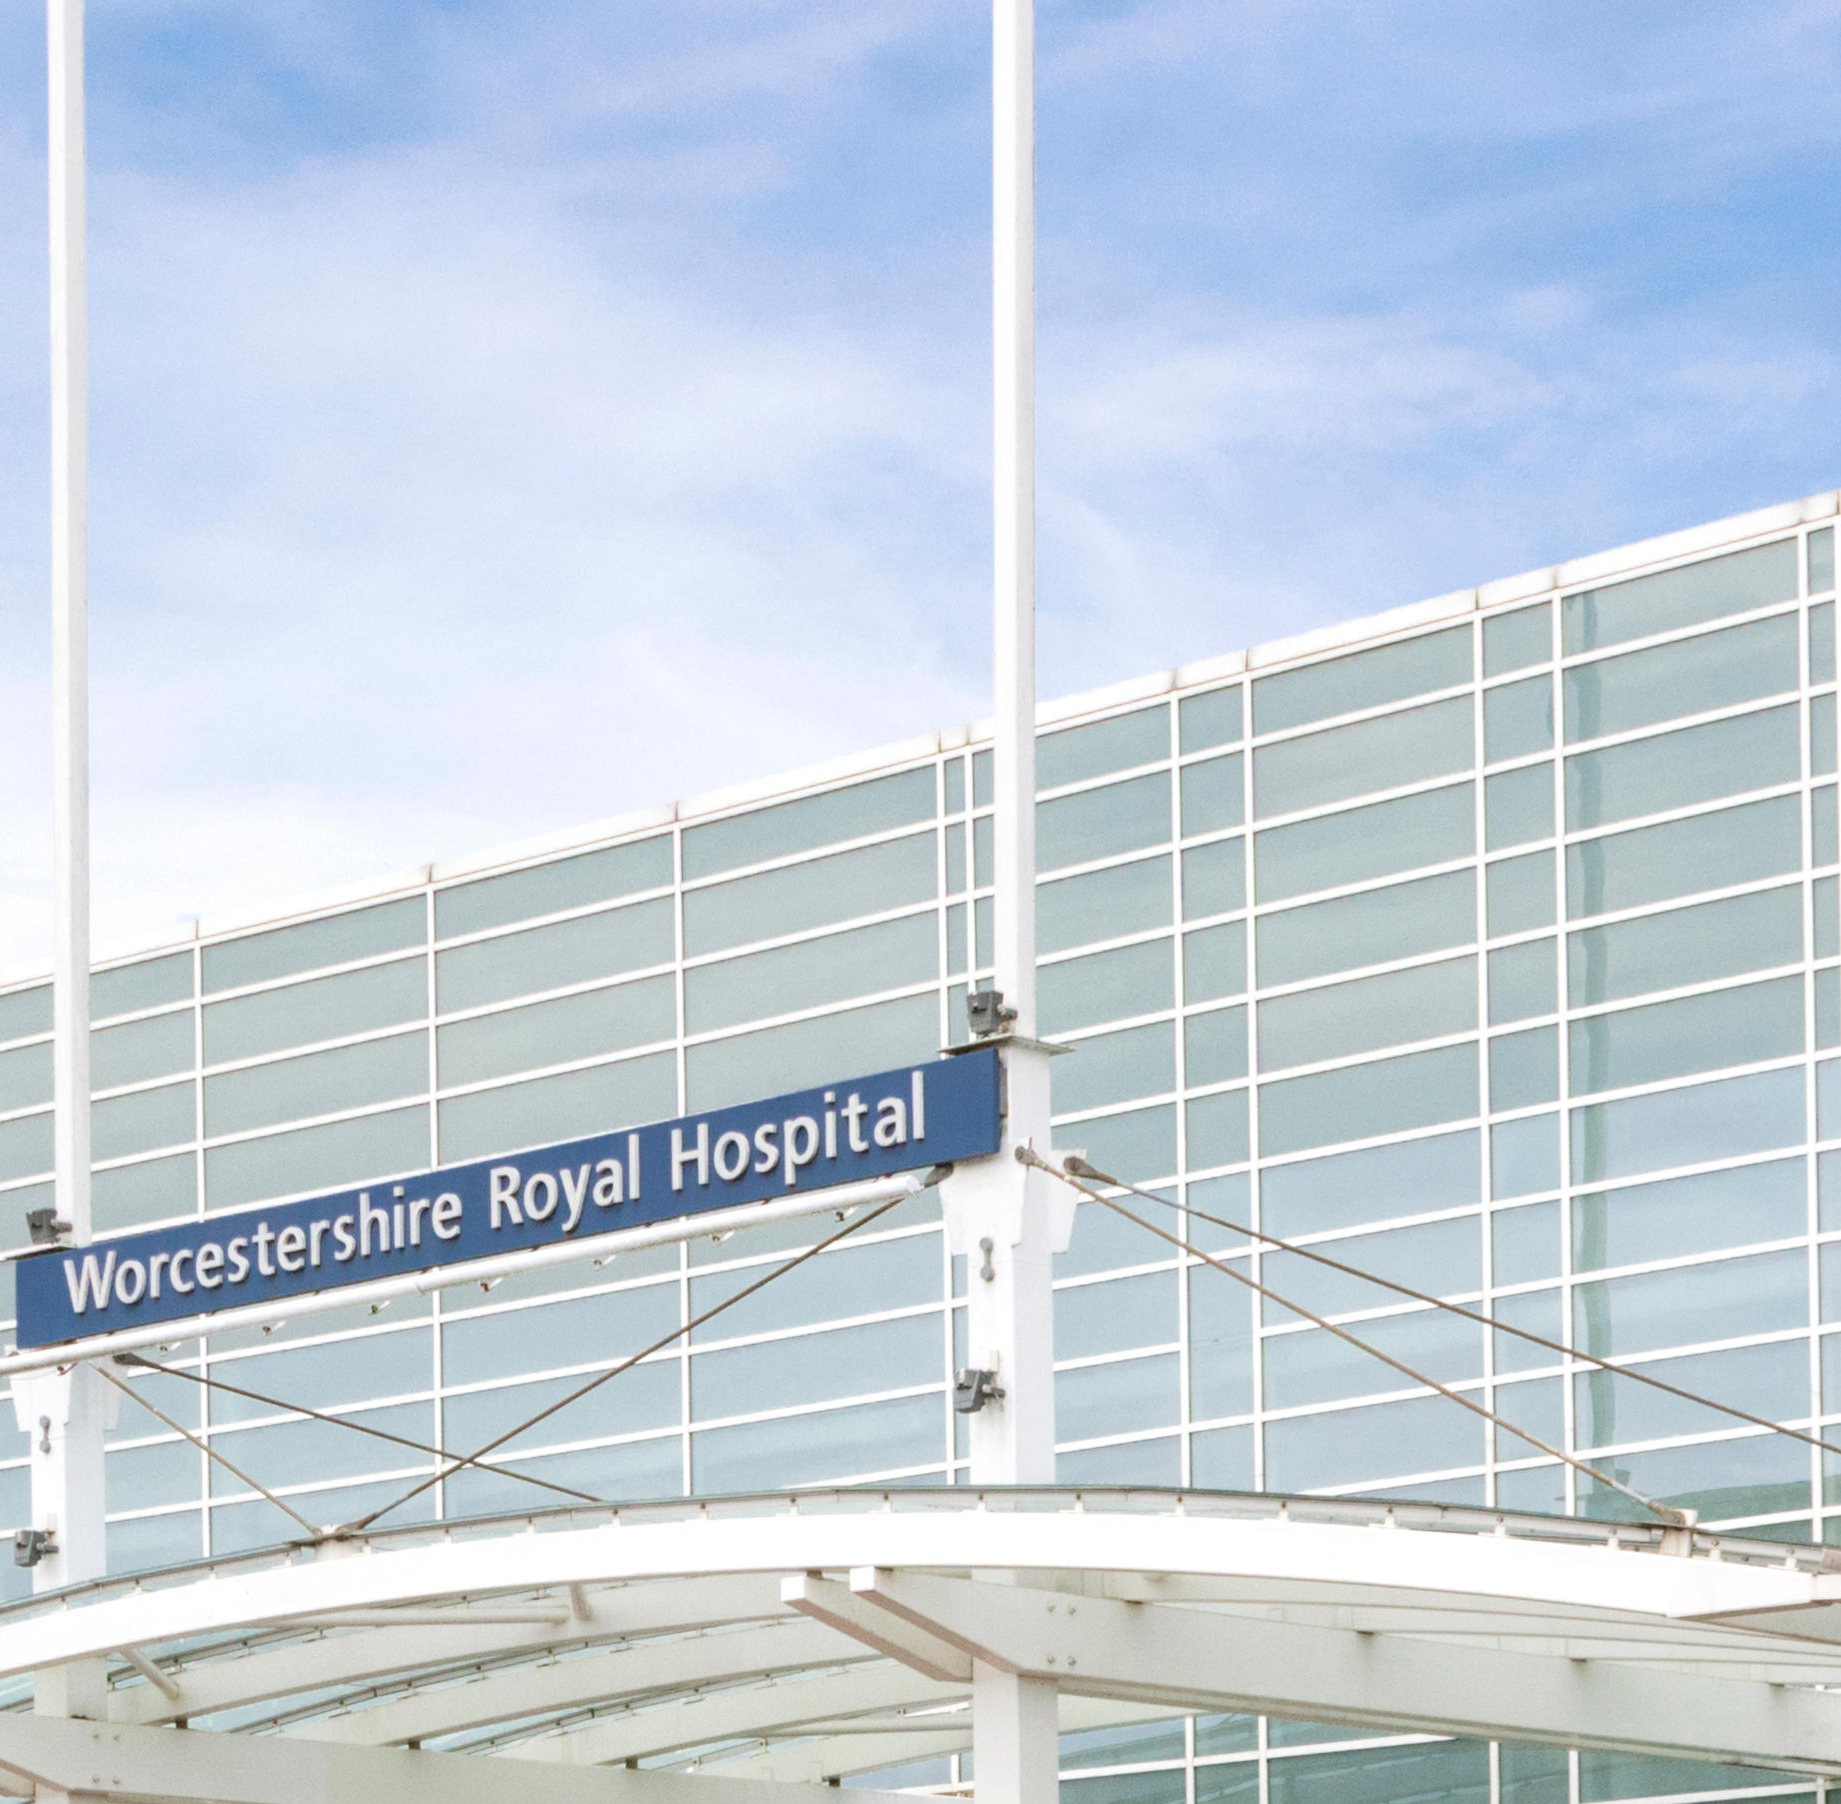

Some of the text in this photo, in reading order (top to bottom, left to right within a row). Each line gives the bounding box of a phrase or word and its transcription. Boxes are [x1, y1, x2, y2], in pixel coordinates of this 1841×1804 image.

[63, 1070, 925, 1314] Worcestershire Royal Hospital
